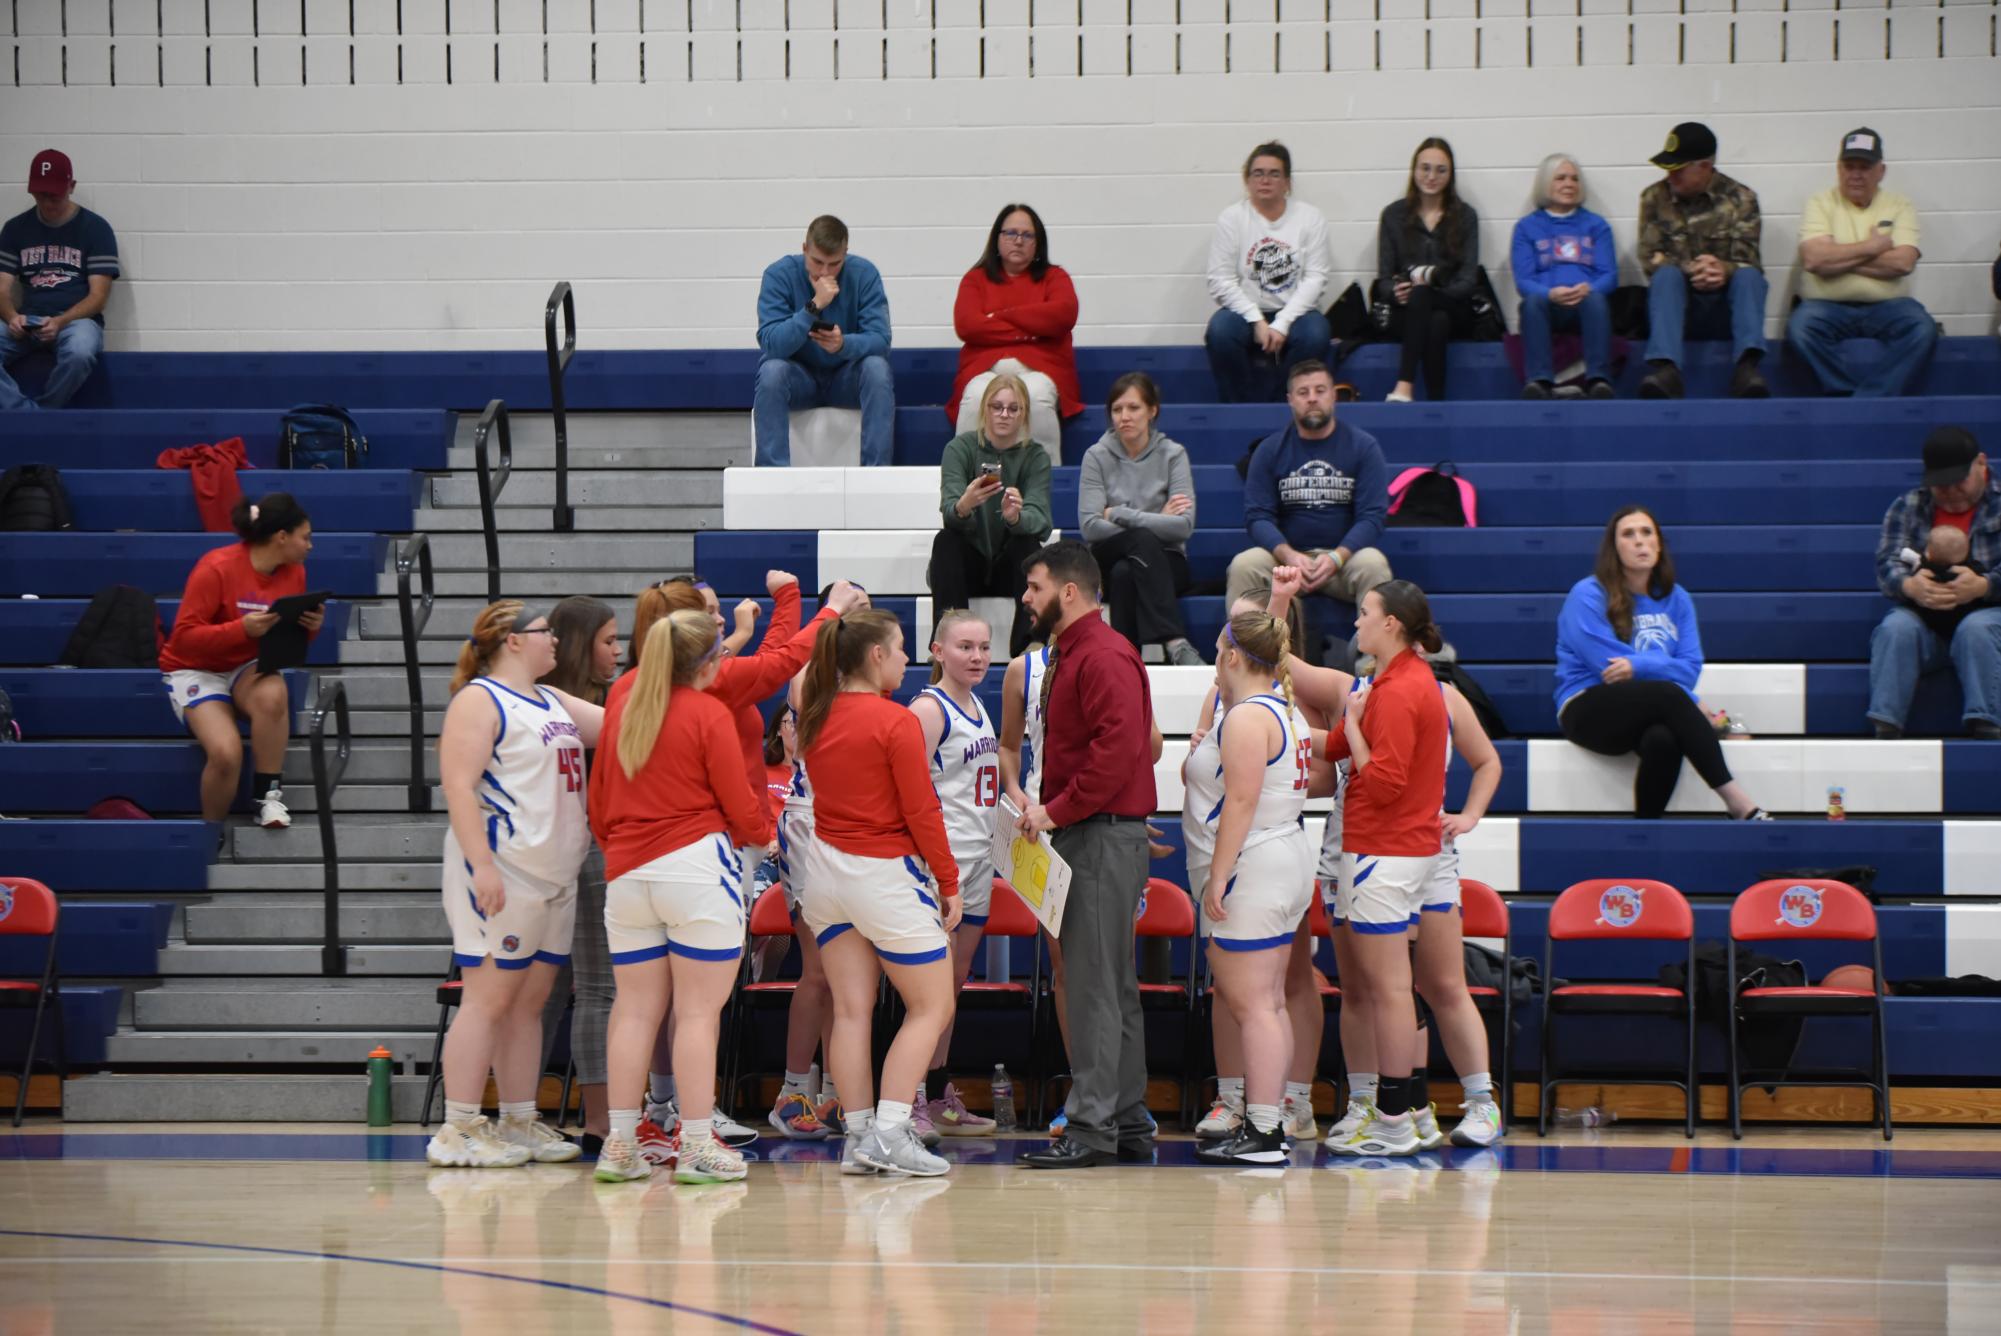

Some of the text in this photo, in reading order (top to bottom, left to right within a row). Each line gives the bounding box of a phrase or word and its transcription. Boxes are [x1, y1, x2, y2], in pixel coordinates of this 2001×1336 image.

[41, 162, 52, 176] P
[20, 245, 82, 268] WEST BRANCH
[557, 748, 582, 793] 45
[1293, 738, 1311, 791] 55
[974, 765, 998, 807] 13
